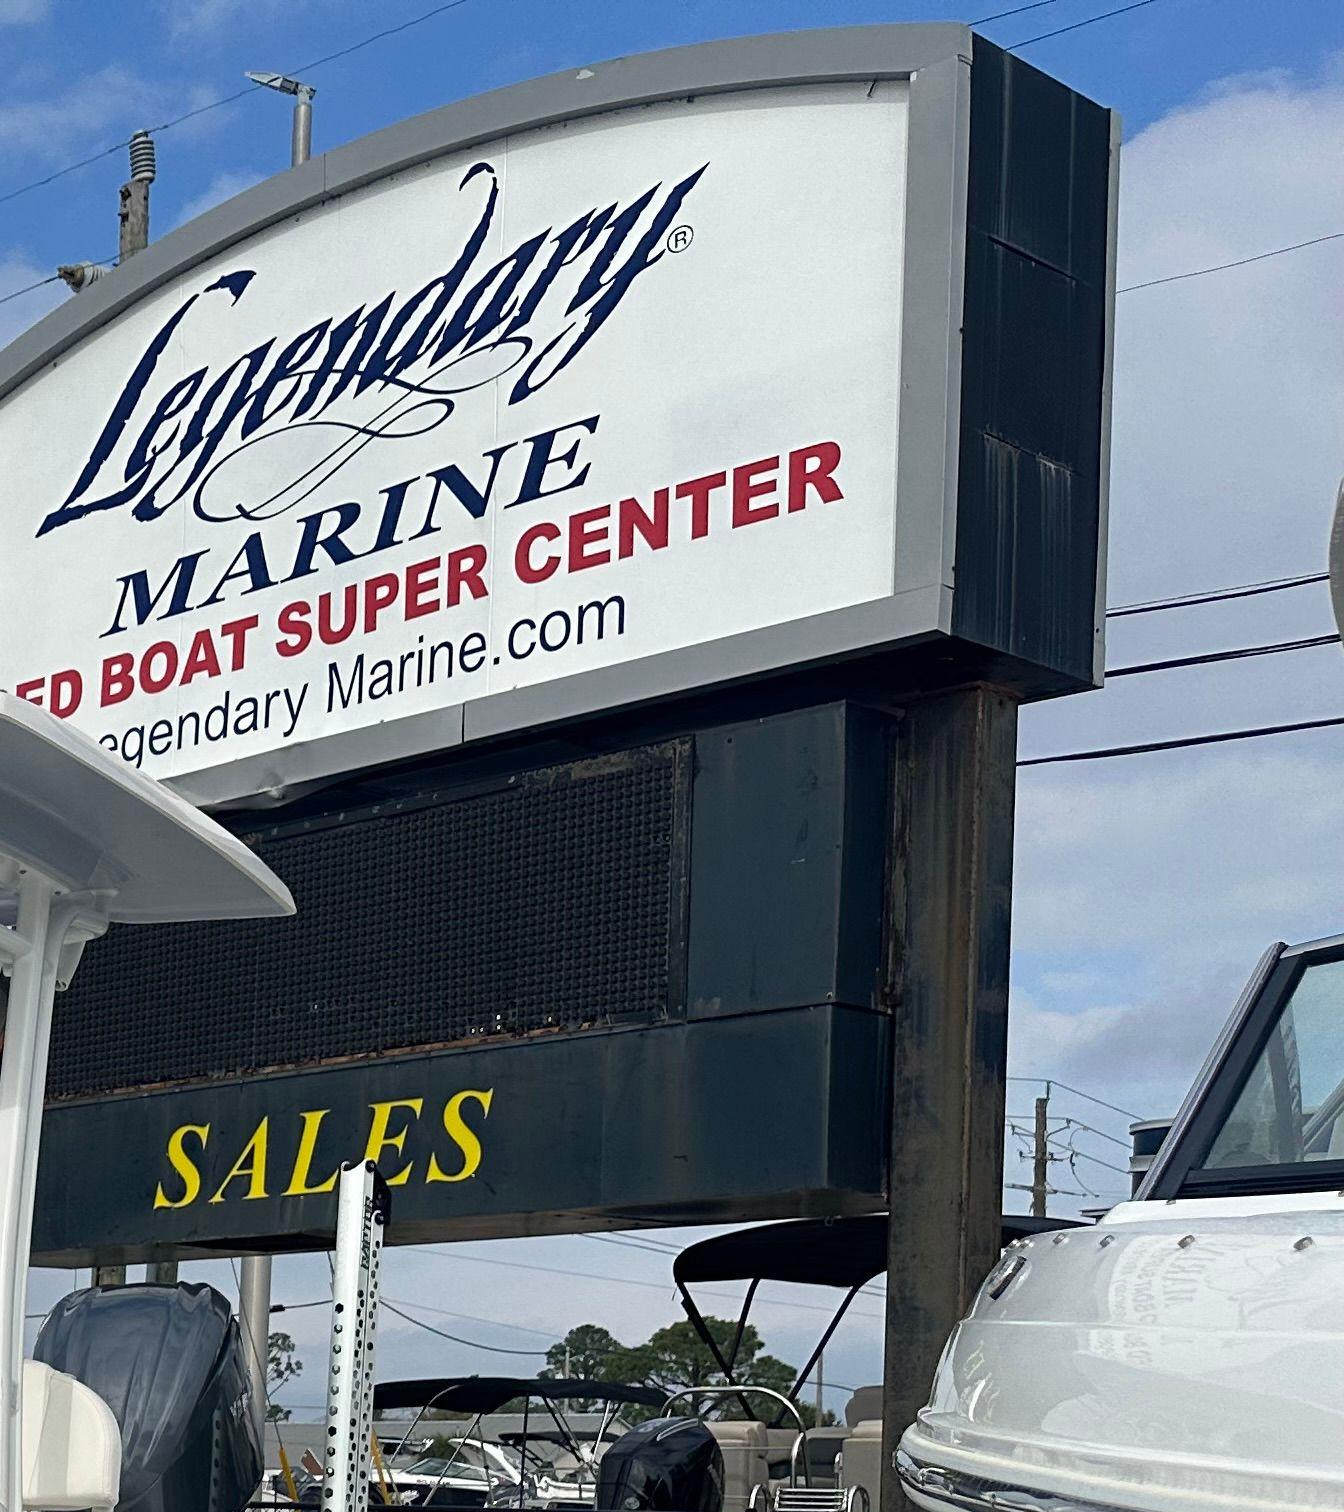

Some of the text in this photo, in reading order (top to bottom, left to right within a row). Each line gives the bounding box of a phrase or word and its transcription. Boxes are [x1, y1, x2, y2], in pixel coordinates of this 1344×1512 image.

[36, 162, 711, 539] Legendary
[16, 441, 842, 718] ED BOAT SUPER CENTER
[99, 414, 600, 638] MARINE
[327, 595, 625, 713] Marine.com
[153, 1088, 495, 1210] SALES
